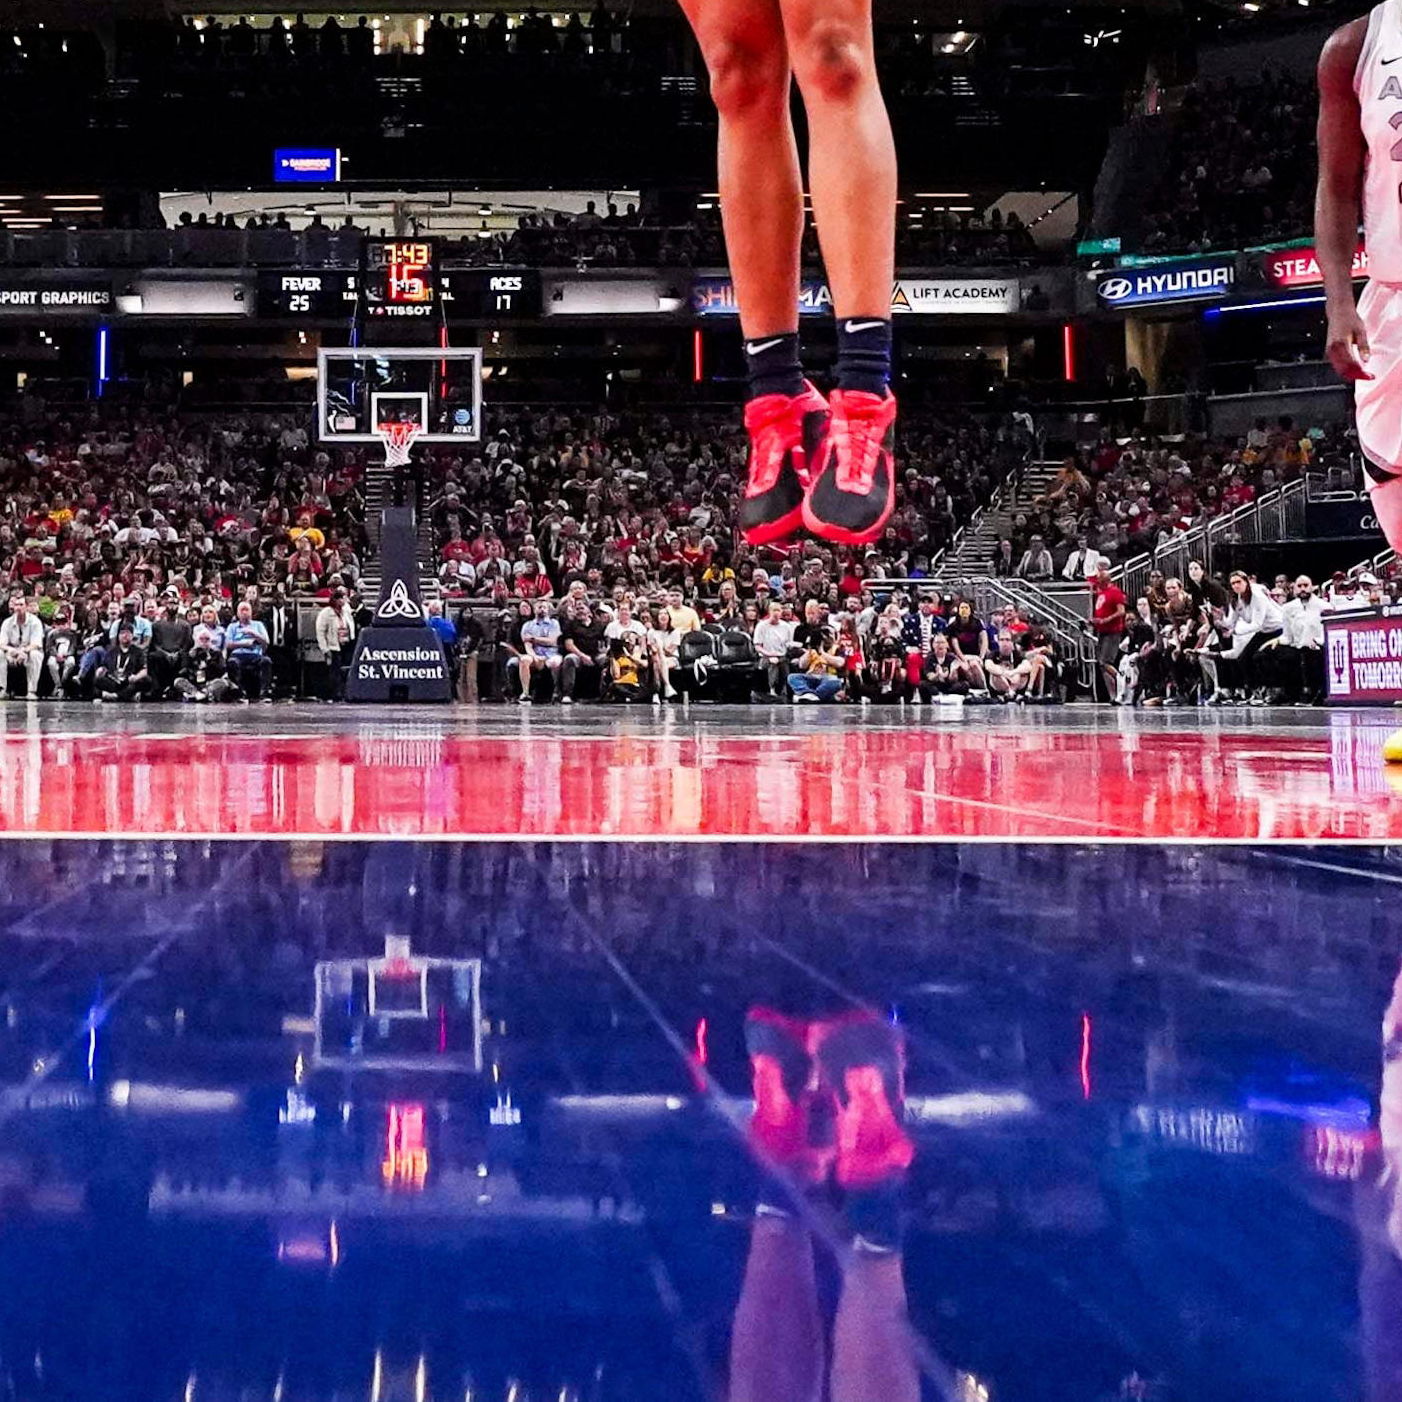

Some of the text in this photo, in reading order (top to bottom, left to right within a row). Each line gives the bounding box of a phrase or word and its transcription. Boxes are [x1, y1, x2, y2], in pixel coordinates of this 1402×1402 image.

[384, 244, 428, 264] 7:43
[282, 278, 322, 291] FEVER
[490, 277, 522, 290] ACES
[1137, 267, 1235, 296] HYUNDAI
[41, 290, 110, 304] GRAPHICS
[913, 287, 1008, 299] LIFT ACADEMY
[385, 306, 432, 316] TISSOT
[1351, 629, 1387, 658] BRING
[359, 646, 440, 661] Ascension
[358, 663, 444, 680] St. Vincent
